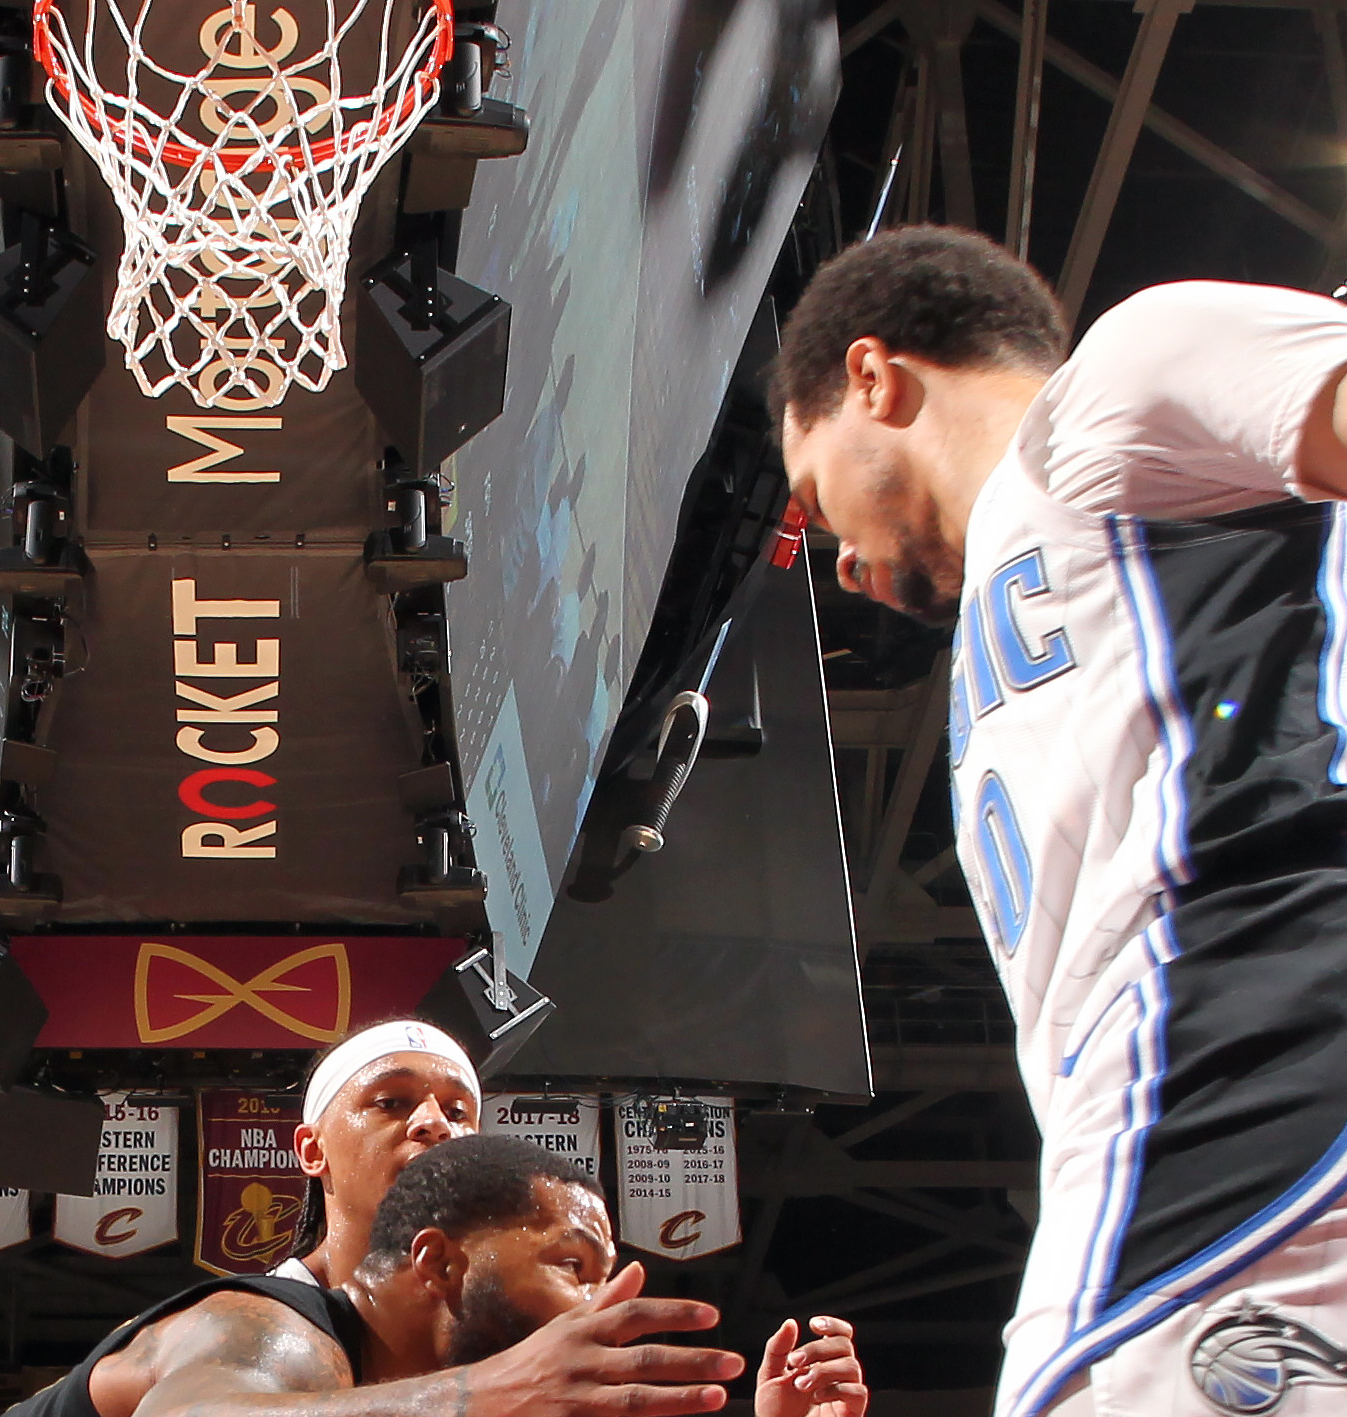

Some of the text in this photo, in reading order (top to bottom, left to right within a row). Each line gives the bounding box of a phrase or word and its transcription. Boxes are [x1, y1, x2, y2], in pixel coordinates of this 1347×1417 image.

[171, 577, 281, 859] ROCKET
[494, 791, 531, 946] Cleveland Clinic
[104, 1104, 159, 1122] 15-16
[102, 1131, 155, 1149] STERN
[241, 1129, 277, 1148] NBA
[98, 1154, 171, 1172] FERENCE
[209, 1150, 299, 1169] CHAMPION
[628, 1160, 724, 1169] 2008-09 2016-17
[94, 1178, 165, 1196] AMPIONS
[628, 1174, 725, 1183] 2009-10 2017-18
[629, 1189, 671, 1198] 2014-15
